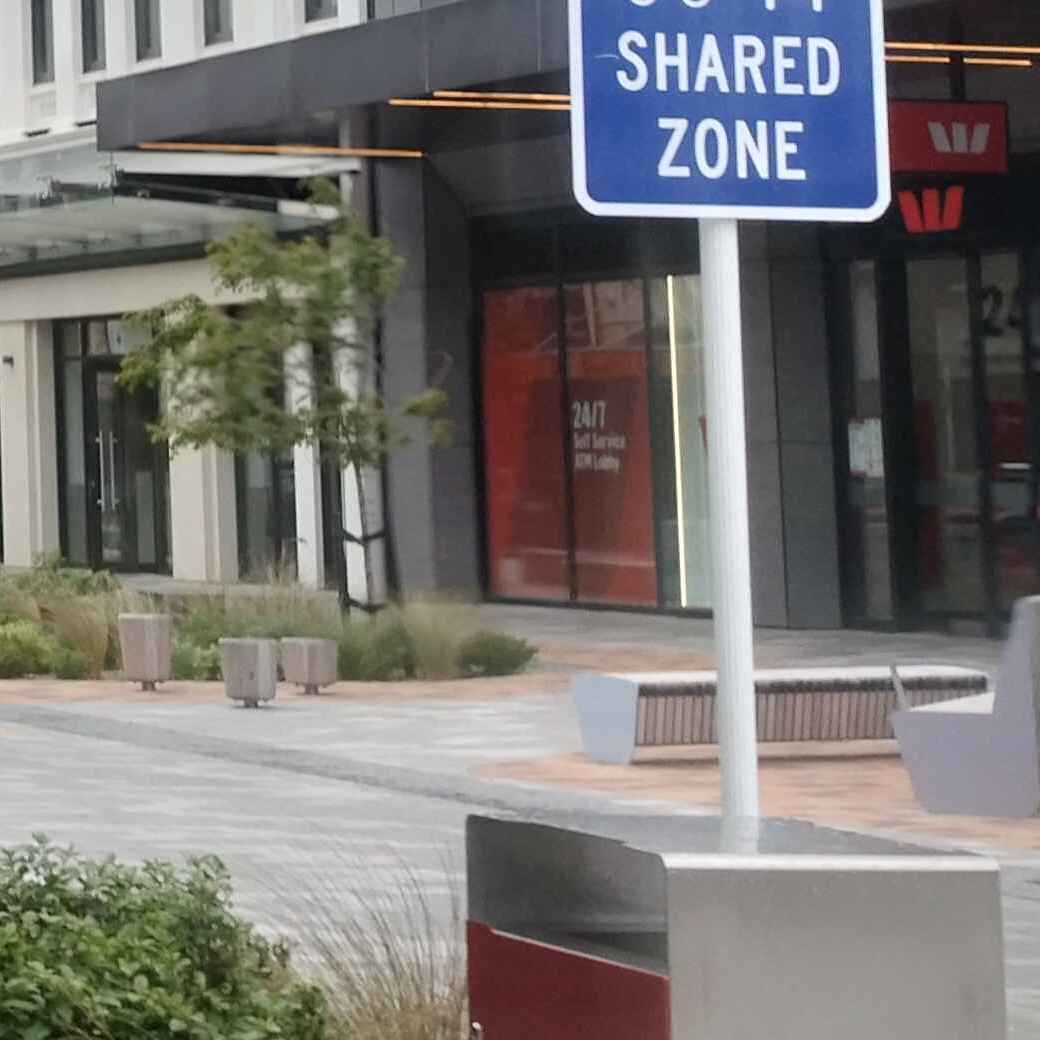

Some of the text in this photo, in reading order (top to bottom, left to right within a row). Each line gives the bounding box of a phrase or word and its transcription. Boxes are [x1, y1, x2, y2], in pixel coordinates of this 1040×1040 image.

[616, 29, 841, 96] SHARED
[657, 117, 807, 180] ZONE
[571, 400, 607, 431] 24/7
